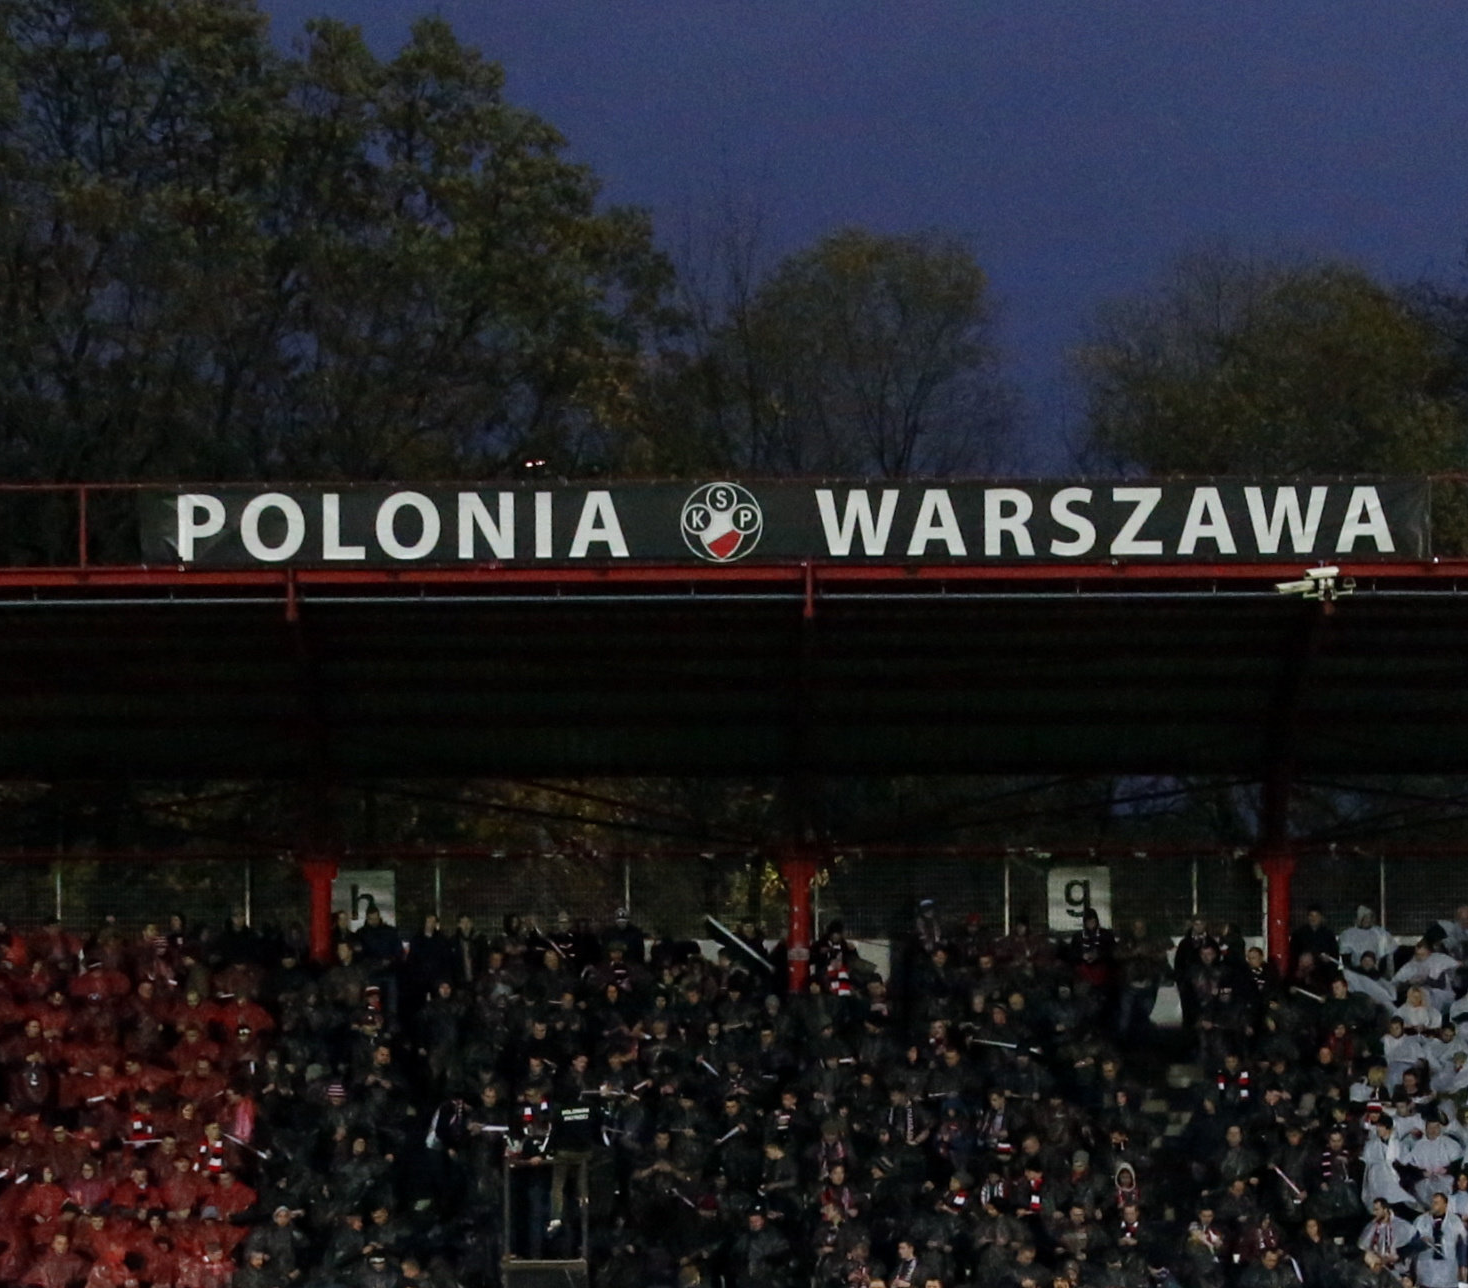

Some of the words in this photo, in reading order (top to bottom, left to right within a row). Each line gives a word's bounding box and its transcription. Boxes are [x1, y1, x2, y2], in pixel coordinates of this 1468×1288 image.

[177, 490, 630, 562] POLONIA
[815, 485, 1396, 557] WARSZAWA
[350, 884, 375, 920] h
